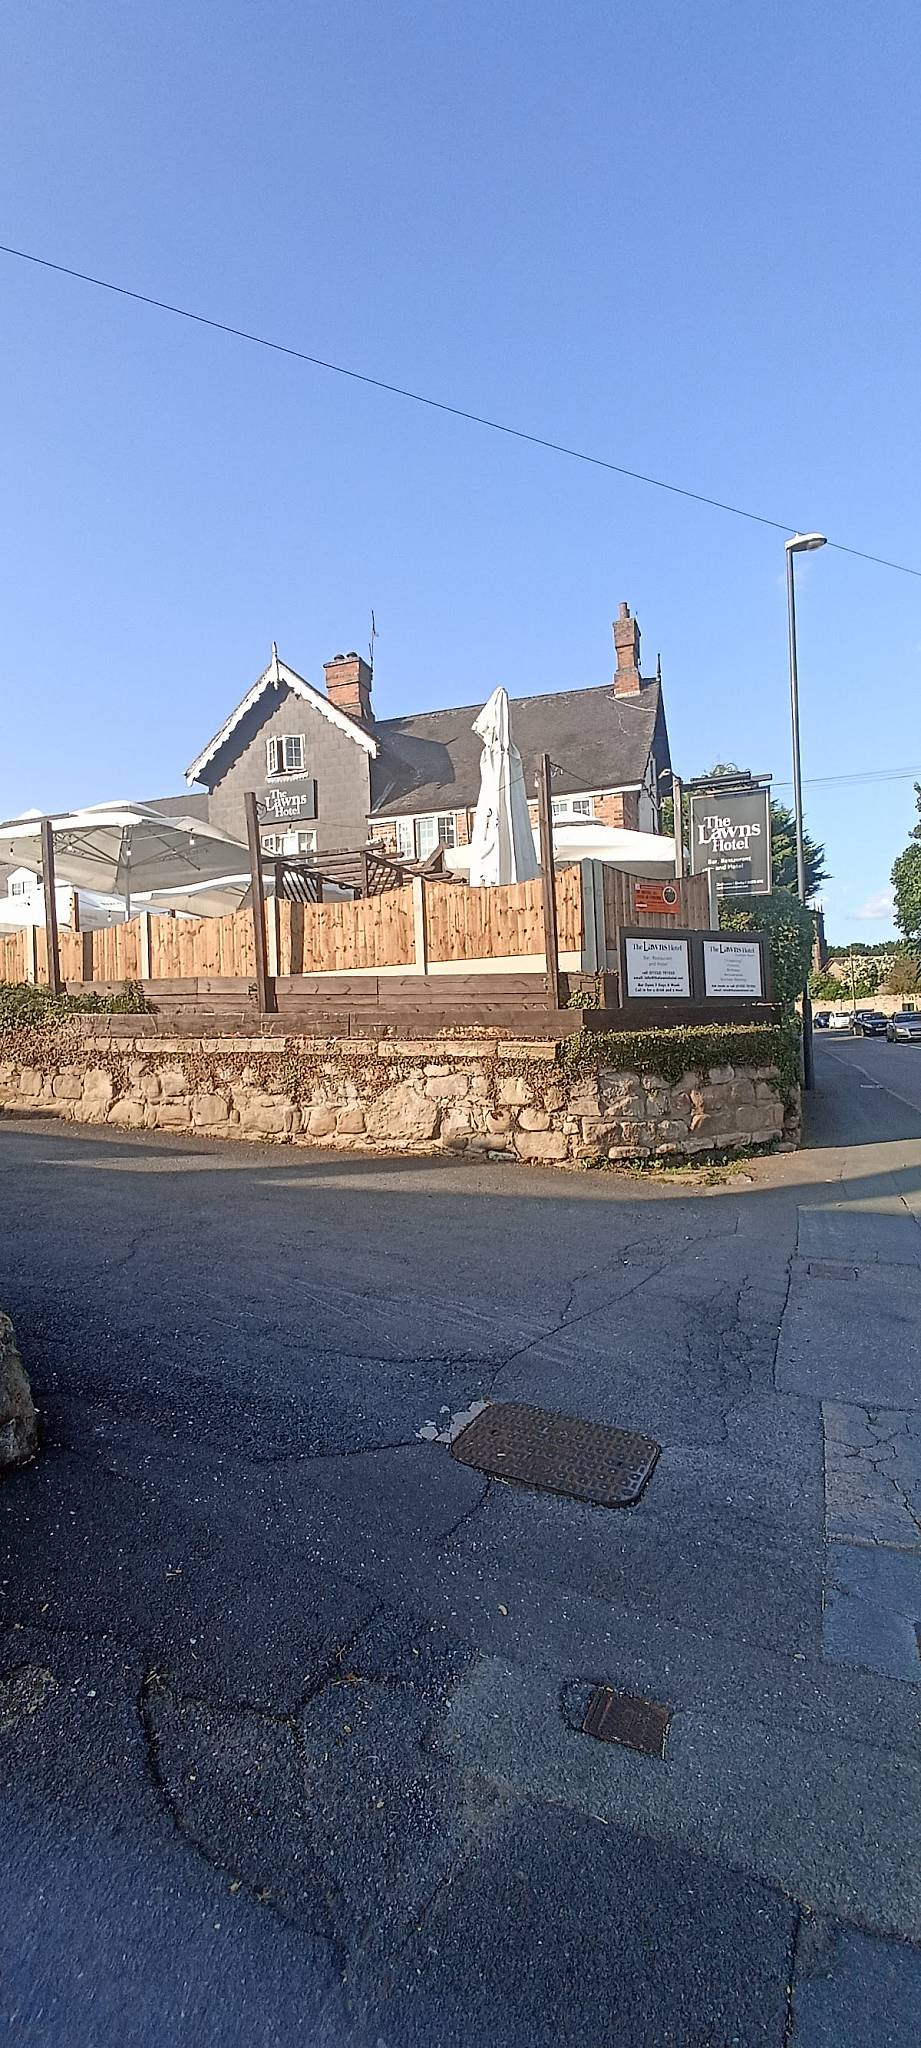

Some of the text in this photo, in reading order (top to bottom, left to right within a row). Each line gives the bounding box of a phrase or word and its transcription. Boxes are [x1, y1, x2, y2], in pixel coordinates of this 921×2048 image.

[270, 789, 287, 799] The
[264, 794, 307, 811] Lawns
[275, 804, 301, 817] Hotel
[703, 815, 731, 829] The
[698, 823, 761, 845] Lawns
[712, 837, 750, 852] Hotel
[643, 941, 667, 951] Lawns
[719, 944, 741, 954] Lawns
